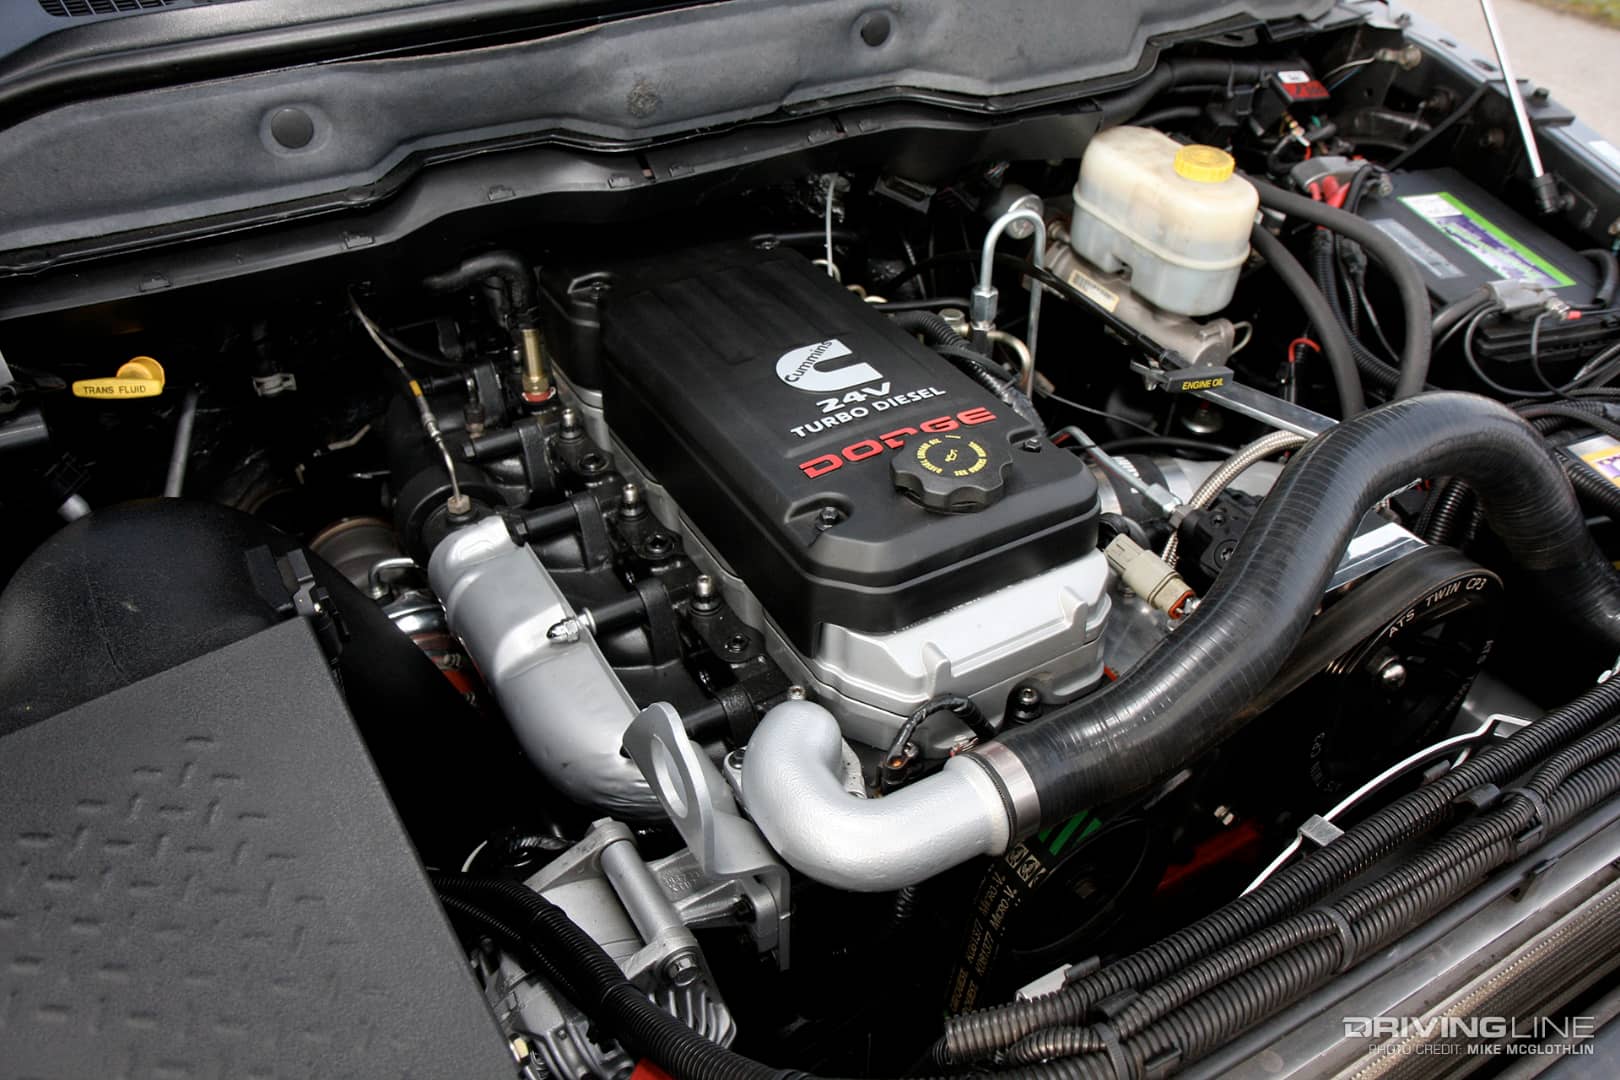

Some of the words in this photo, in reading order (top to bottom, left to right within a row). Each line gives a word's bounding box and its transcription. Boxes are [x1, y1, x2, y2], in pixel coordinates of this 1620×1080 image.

[784, 340, 833, 383] Cummins
[83, 386, 114, 394] TRANS
[119, 385, 146, 393] FLUID
[816, 381, 891, 414] 24V
[1182, 379, 1212, 390] ENGINE
[1212, 377, 1224, 387] OIL
[790, 406, 869, 438] TURBO
[871, 386, 947, 411] DIESEL
[1389, 609, 1415, 638] ATS
[1425, 581, 1461, 607] TWIN
[1466, 578, 1487, 590] CP3
